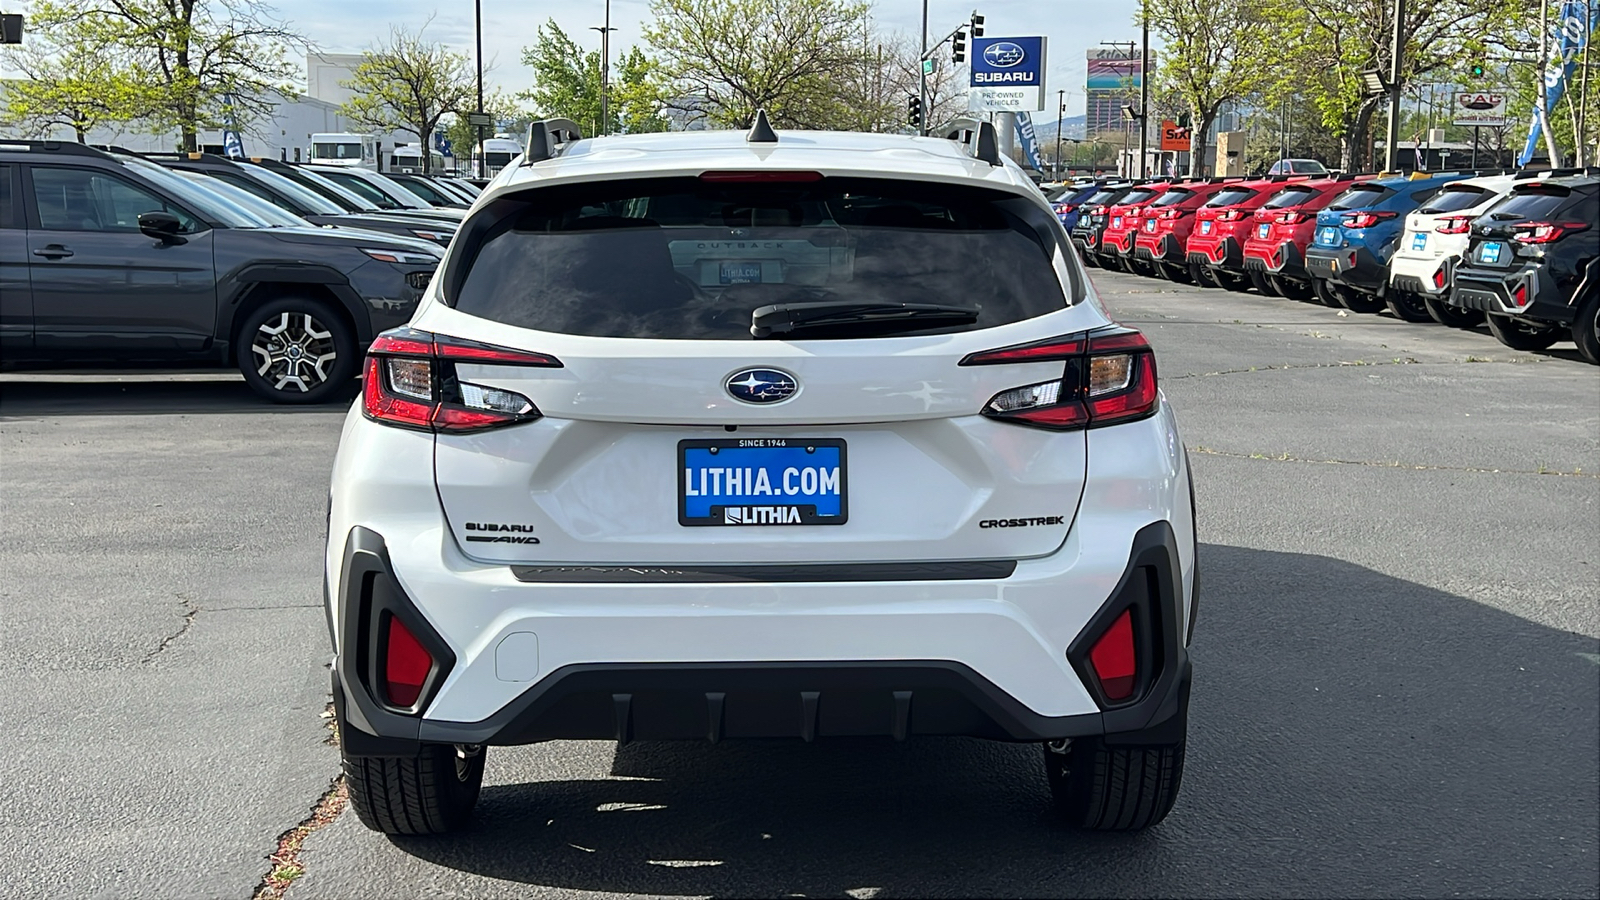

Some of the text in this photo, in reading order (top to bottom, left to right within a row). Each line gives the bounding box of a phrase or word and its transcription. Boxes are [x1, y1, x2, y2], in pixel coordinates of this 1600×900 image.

[975, 72, 1034, 82] SUBARU
[721, 268, 760, 278] LITHIA.COM
[739, 439, 786, 447] SINCE 1946
[685, 467, 840, 496] LITHIA.COM
[742, 506, 801, 524] LITHIA
[979, 516, 1064, 528] CROSSTREK
[465, 522, 533, 533] SUBARU
[493, 536, 540, 544] AWD
